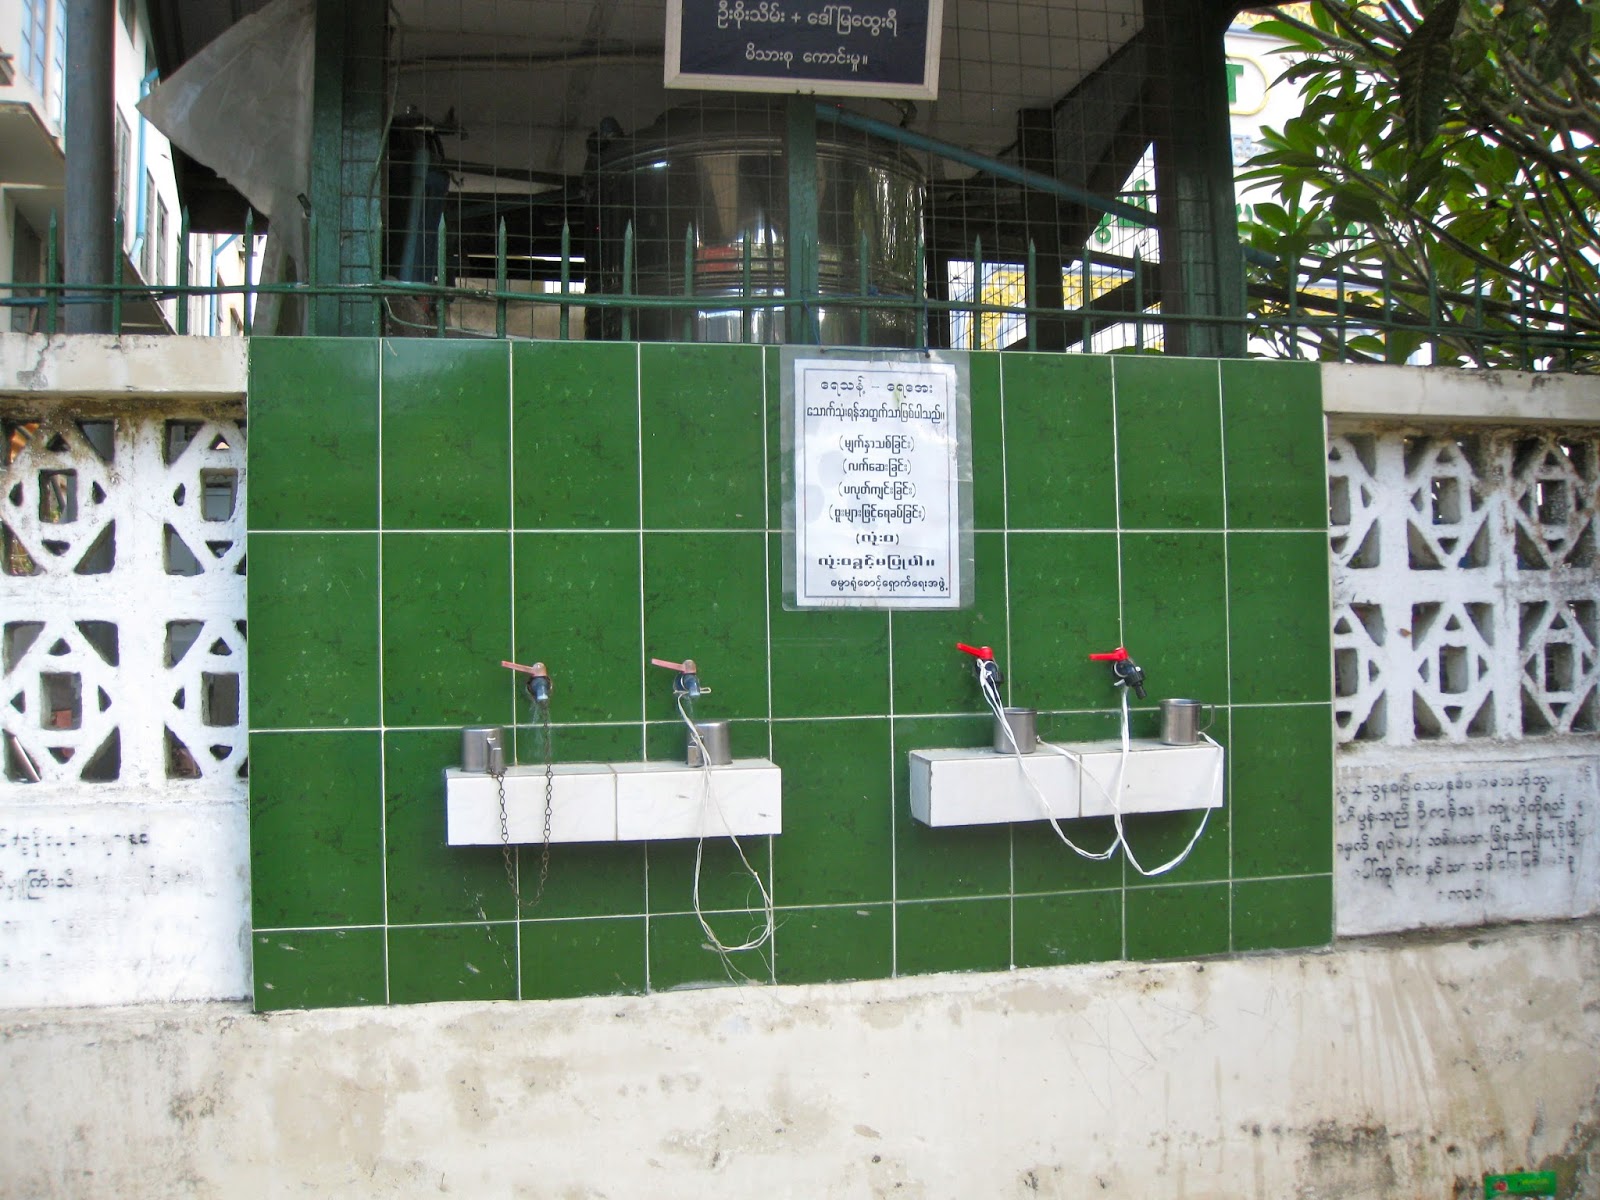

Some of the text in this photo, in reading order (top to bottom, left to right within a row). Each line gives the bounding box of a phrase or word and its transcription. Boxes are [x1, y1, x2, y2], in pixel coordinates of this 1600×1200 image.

[791, 12, 802, 24] +
[745, 42, 794, 69] မိသားစု
[820, 375, 866, 397] ရေသန့်
[886, 382, 933, 398] ရေအေး
